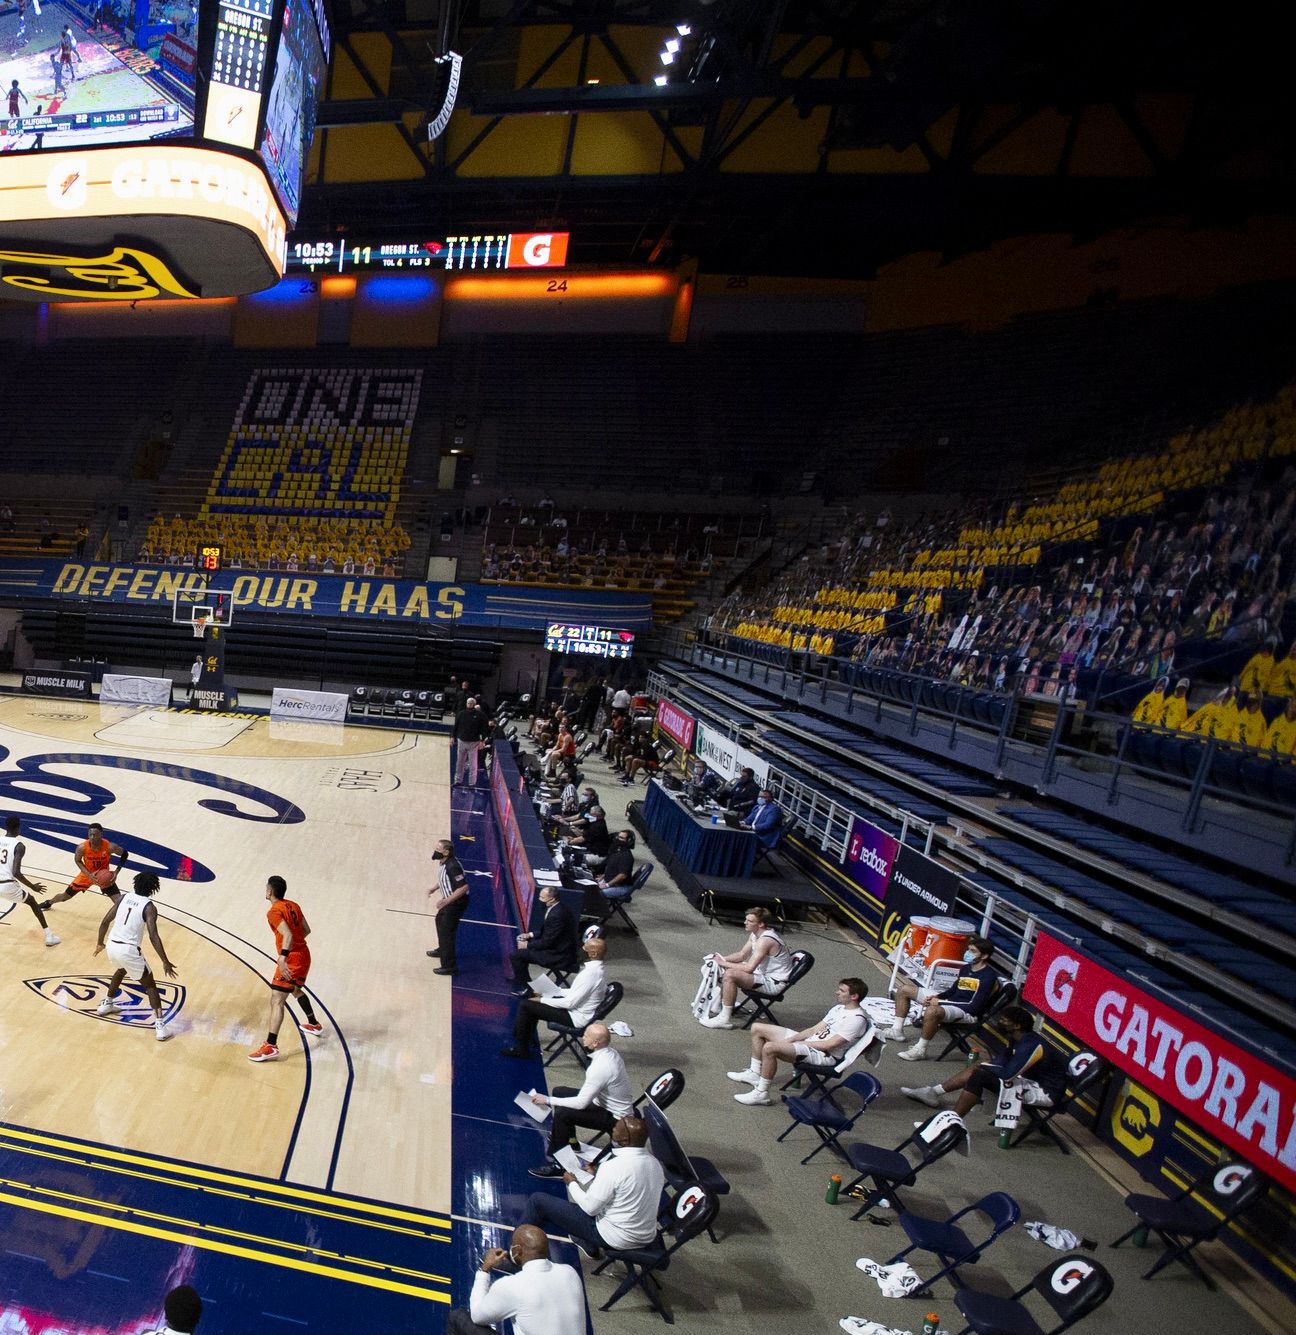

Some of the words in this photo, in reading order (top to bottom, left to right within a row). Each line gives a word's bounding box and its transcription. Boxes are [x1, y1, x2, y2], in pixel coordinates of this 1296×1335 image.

[294, 243, 334, 257] 10:53
[352, 247, 371, 264] 11
[381, 245, 407, 255] OREGON
[409, 245, 419, 255] ST.
[523, 235, 553, 266] G
[547, 280, 568, 292] 24
[205, 556, 217, 569] 13
[51, 563, 207, 602] DEFEND
[233, 575, 318, 610] OUR
[340, 581, 466, 619] HAAS
[547, 624, 565, 638] Cal
[567, 627, 580, 637] 22
[599, 630, 612, 640] 11
[573, 642, 602, 654] 10:53
[36, 676, 65, 688] MUSCLE
[65, 679, 85, 690] MILK
[194, 690, 225, 701] MUSCLE
[199, 700, 218, 709] MILK
[901, 875, 921, 896] UNDER
[920, 889, 949, 913] ARMOUR
[124, 907, 132, 926] 1
[1044, 954, 1081, 1013] G
[1213, 1164, 1253, 1195] G
[1051, 1260, 1094, 1295] G
